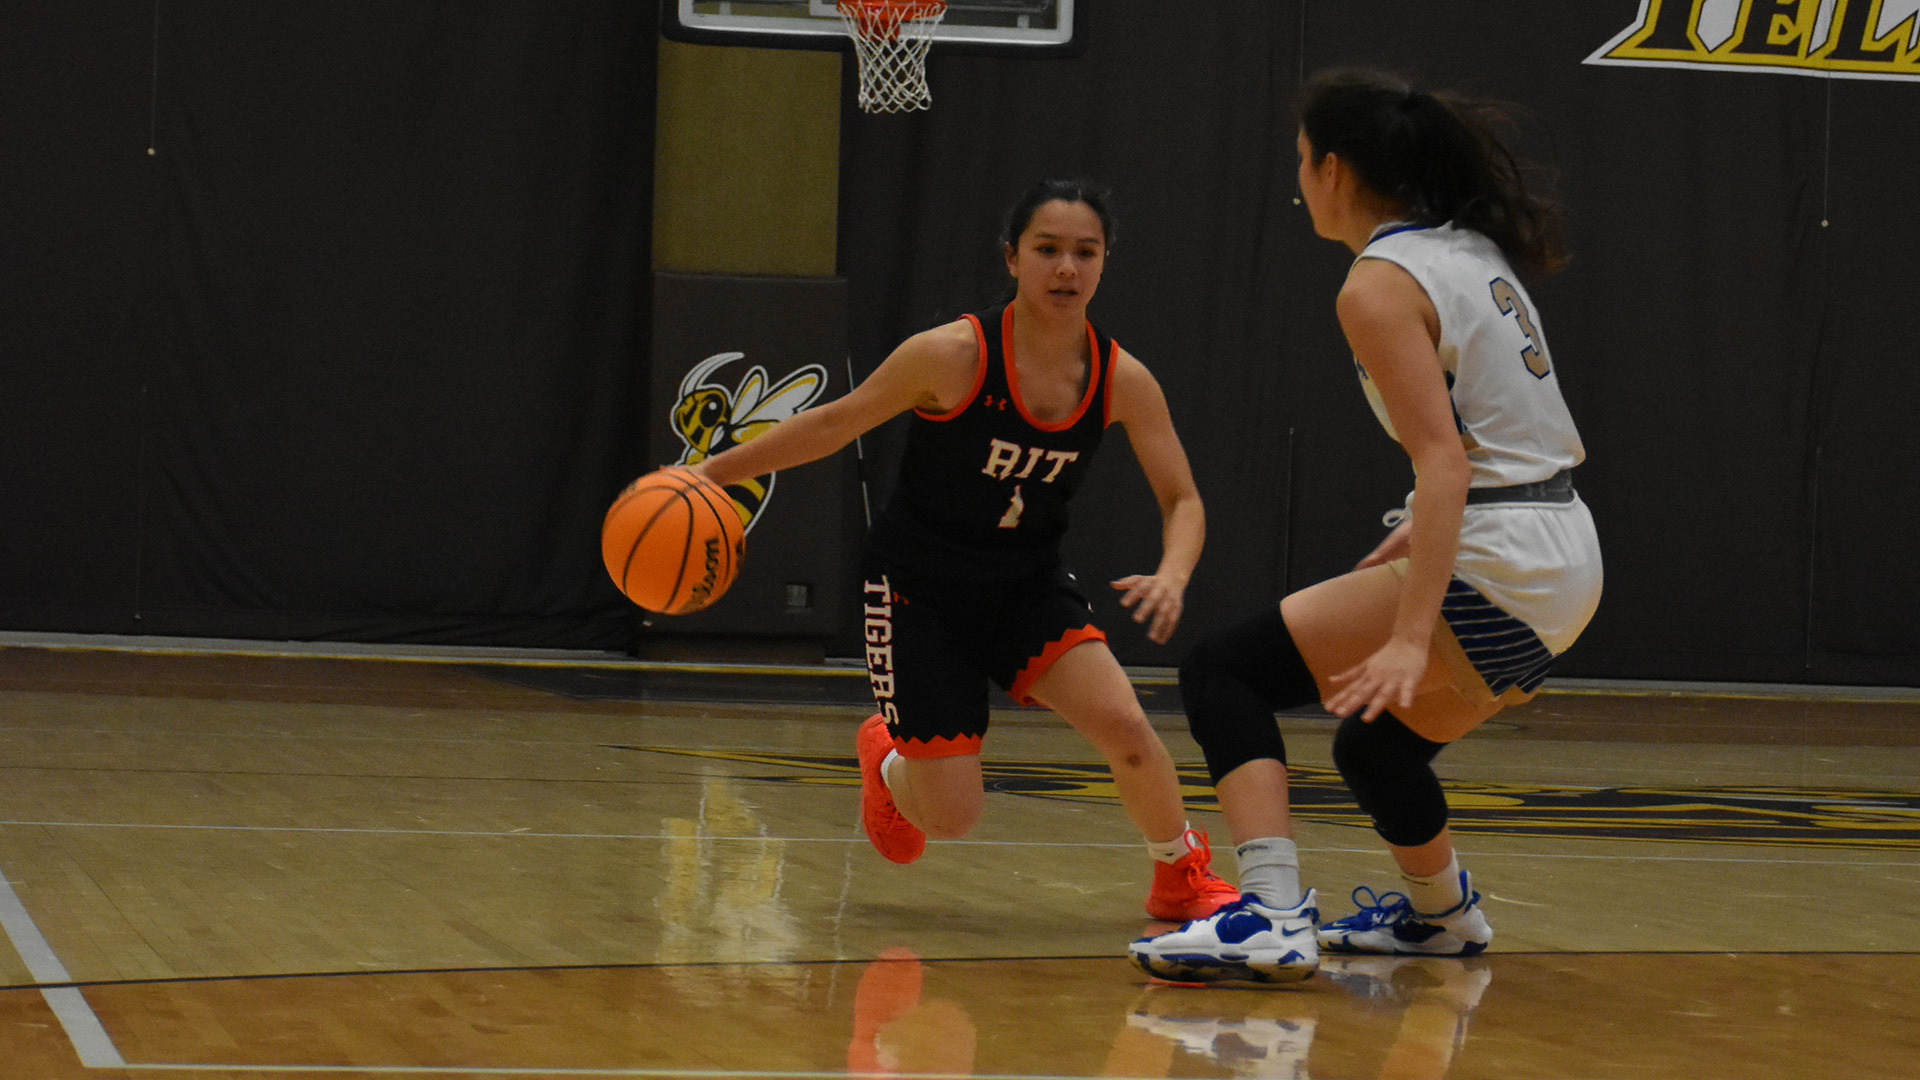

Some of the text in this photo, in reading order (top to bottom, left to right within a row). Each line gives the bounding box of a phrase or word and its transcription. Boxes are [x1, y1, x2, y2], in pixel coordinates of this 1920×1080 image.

[1489, 276, 1551, 381] 3
[981, 437, 1080, 483] RIT
[998, 484, 1025, 529] 1
[863, 574, 900, 726] TIGERS
